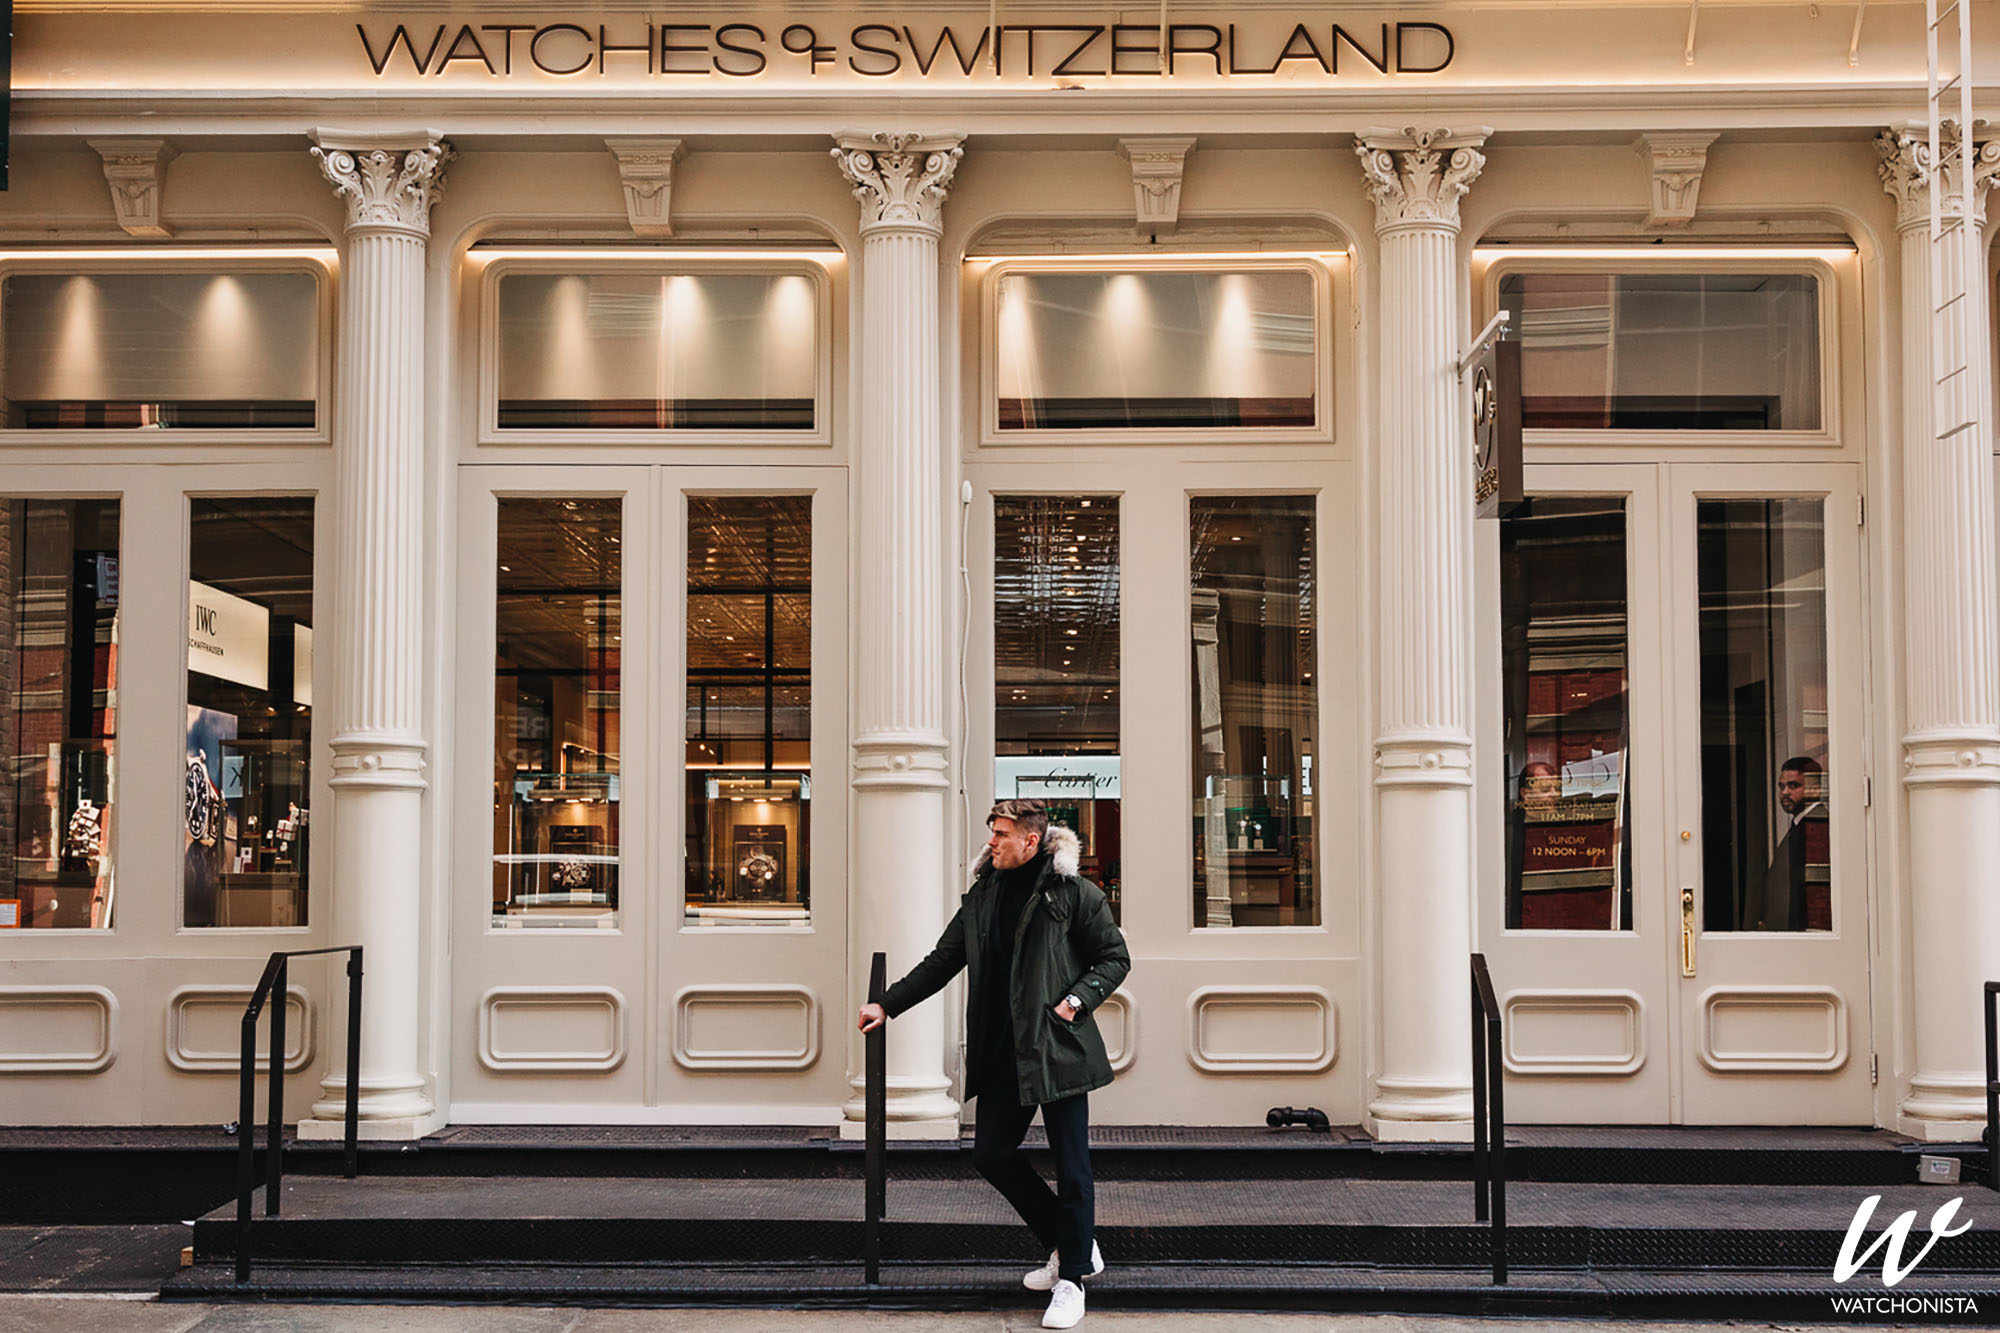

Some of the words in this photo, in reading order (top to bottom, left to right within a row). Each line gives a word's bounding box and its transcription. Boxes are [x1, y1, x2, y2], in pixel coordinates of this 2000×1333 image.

[356, 23, 766, 76] WATCHES
[781, 24, 836, 75] OF
[848, 22, 1455, 76] SWITZERLAND
[196, 604, 217, 636] IWC
[1548, 835, 1587, 845] SUNDAY
[1532, 846, 1542, 856] 12
[1544, 846, 1577, 856] NOON
[1586, 846, 1606, 857] 6PM
